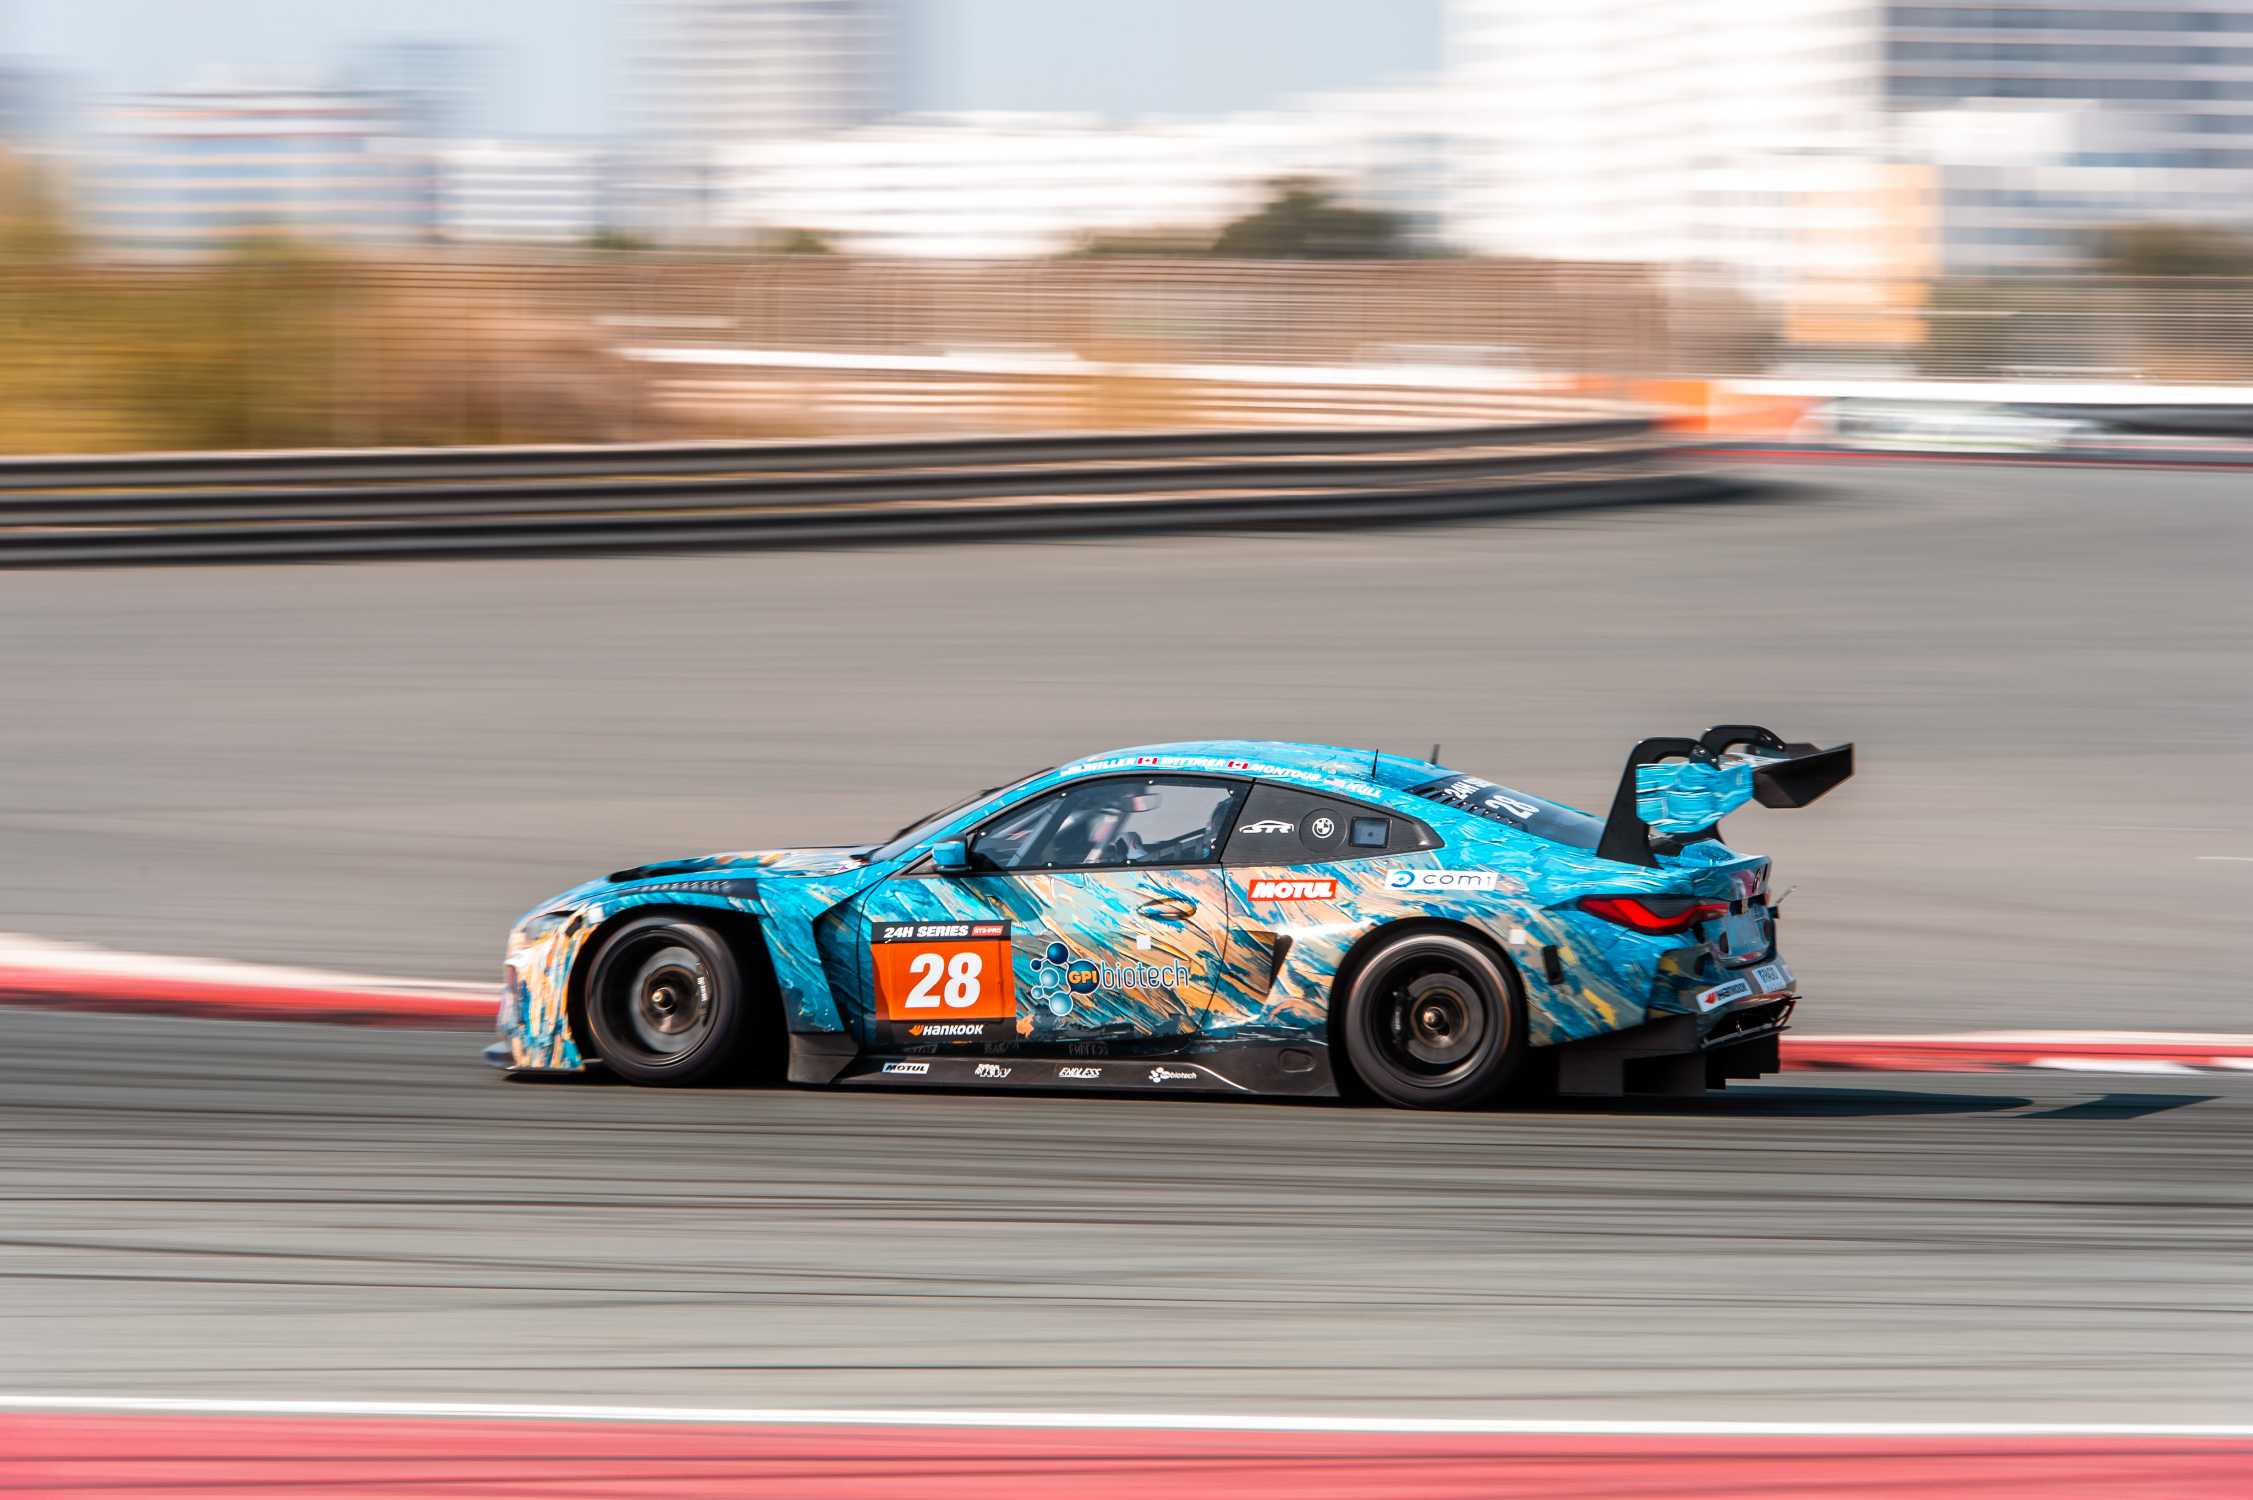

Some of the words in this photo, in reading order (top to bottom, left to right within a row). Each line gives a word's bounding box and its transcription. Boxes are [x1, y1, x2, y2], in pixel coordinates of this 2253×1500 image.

[1251, 881, 1333, 899] MOTUL
[884, 926, 913, 938] 24H
[917, 925, 968, 937] SERIES
[905, 952, 983, 1008] 28
[1068, 971, 1097, 984] GPI
[1101, 960, 1189, 989] biotech
[885, 1064, 927, 1072] MOTUL
[1059, 1067, 1102, 1078] ENDLESS
